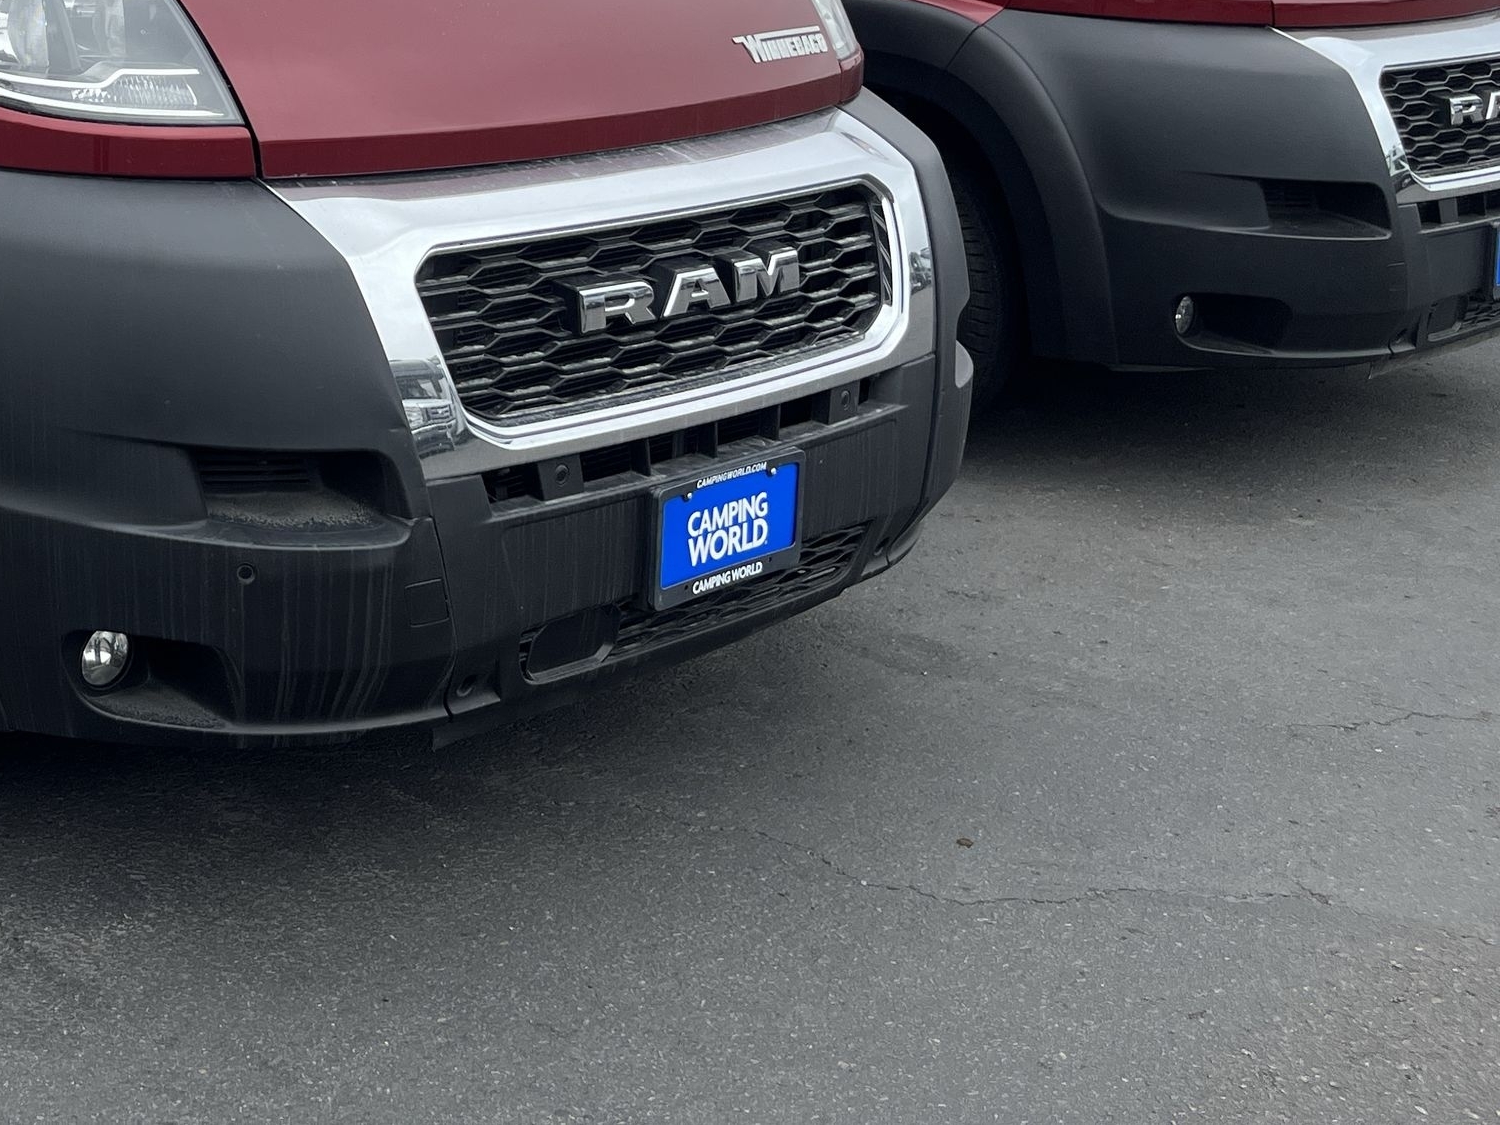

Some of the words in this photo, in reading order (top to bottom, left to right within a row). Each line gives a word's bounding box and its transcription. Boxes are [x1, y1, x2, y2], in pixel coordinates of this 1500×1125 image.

[576, 246, 800, 334] RAM
[696, 462, 767, 489] CAMPINGWORLD.COM
[687, 492, 769, 537] CAMPING
[688, 518, 769, 567] WORLD
[692, 570, 731, 595] CAMPING
[731, 561, 763, 582] WORLD
